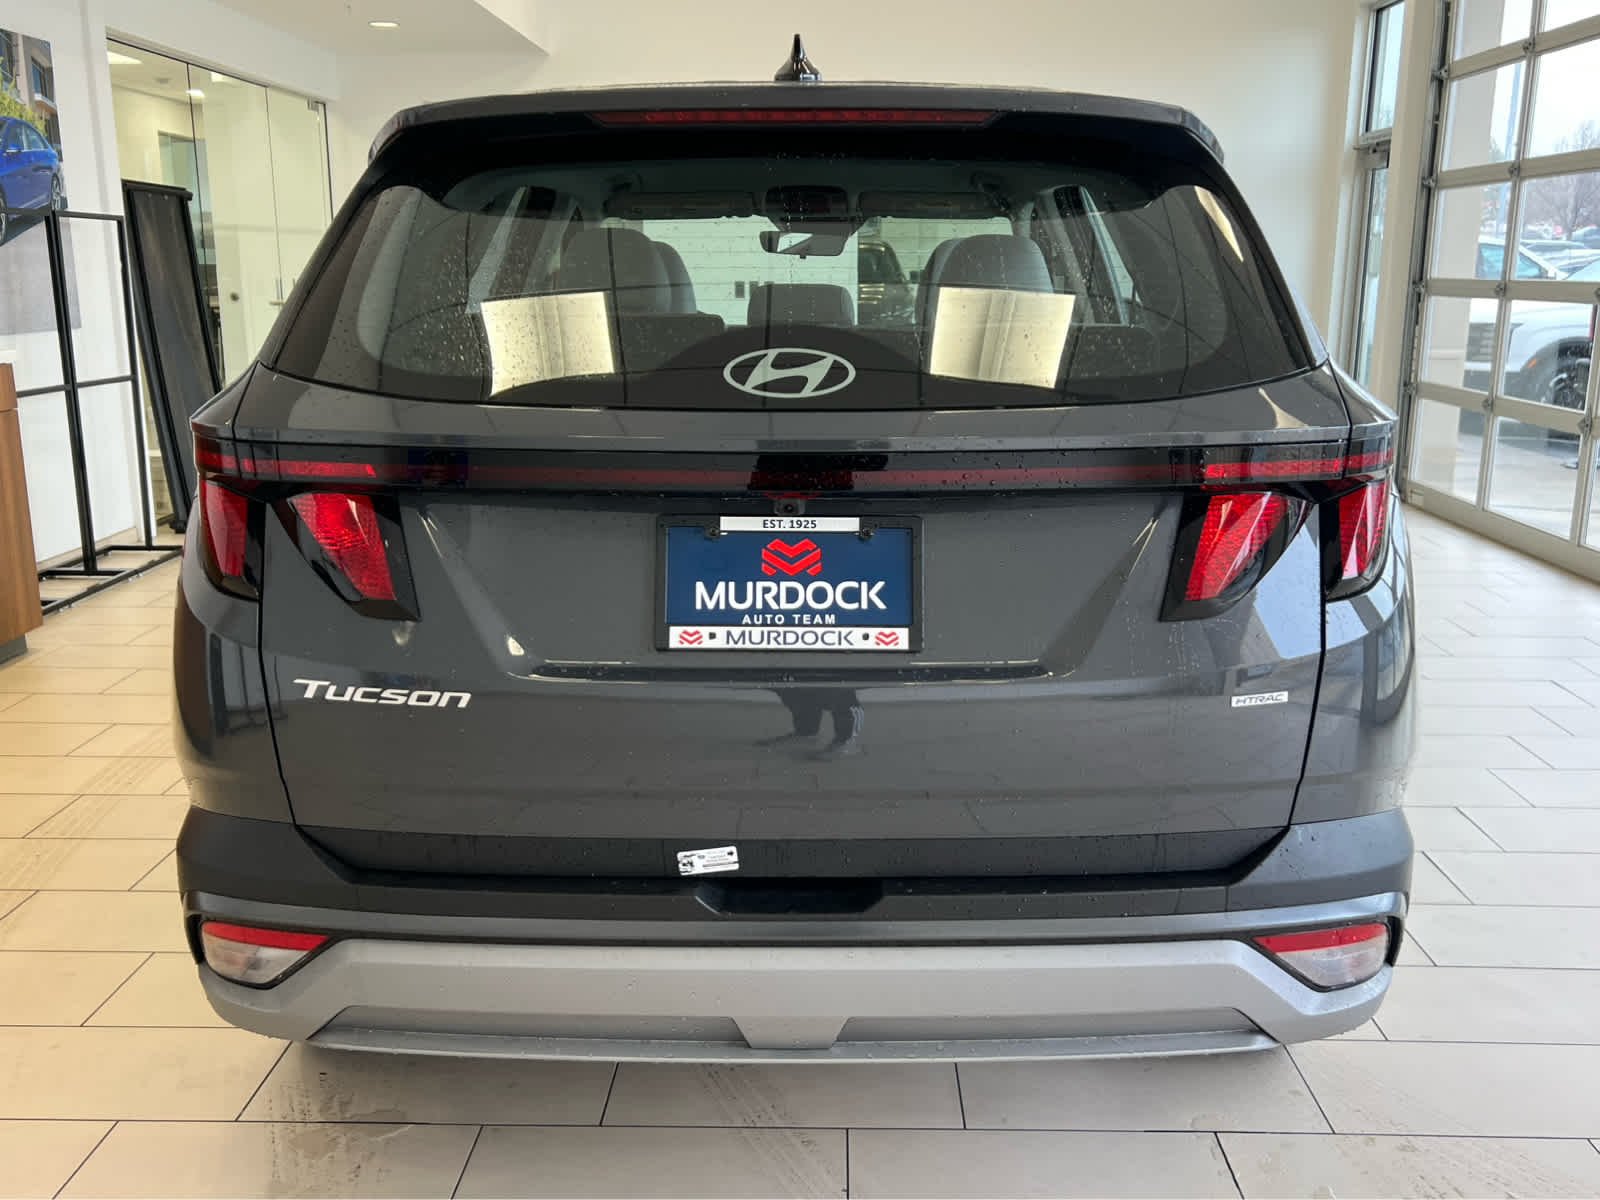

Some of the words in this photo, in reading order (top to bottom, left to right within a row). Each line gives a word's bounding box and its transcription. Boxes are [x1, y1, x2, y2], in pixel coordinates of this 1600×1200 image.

[762, 519, 786, 529] EST.
[789, 519, 817, 529] 1925
[694, 580, 887, 610] MURDOCK
[741, 614, 785, 625] AUTO
[792, 614, 836, 625] TEAM
[725, 629, 854, 646] MURDOCK
[1235, 693, 1285, 705] HTRAC
